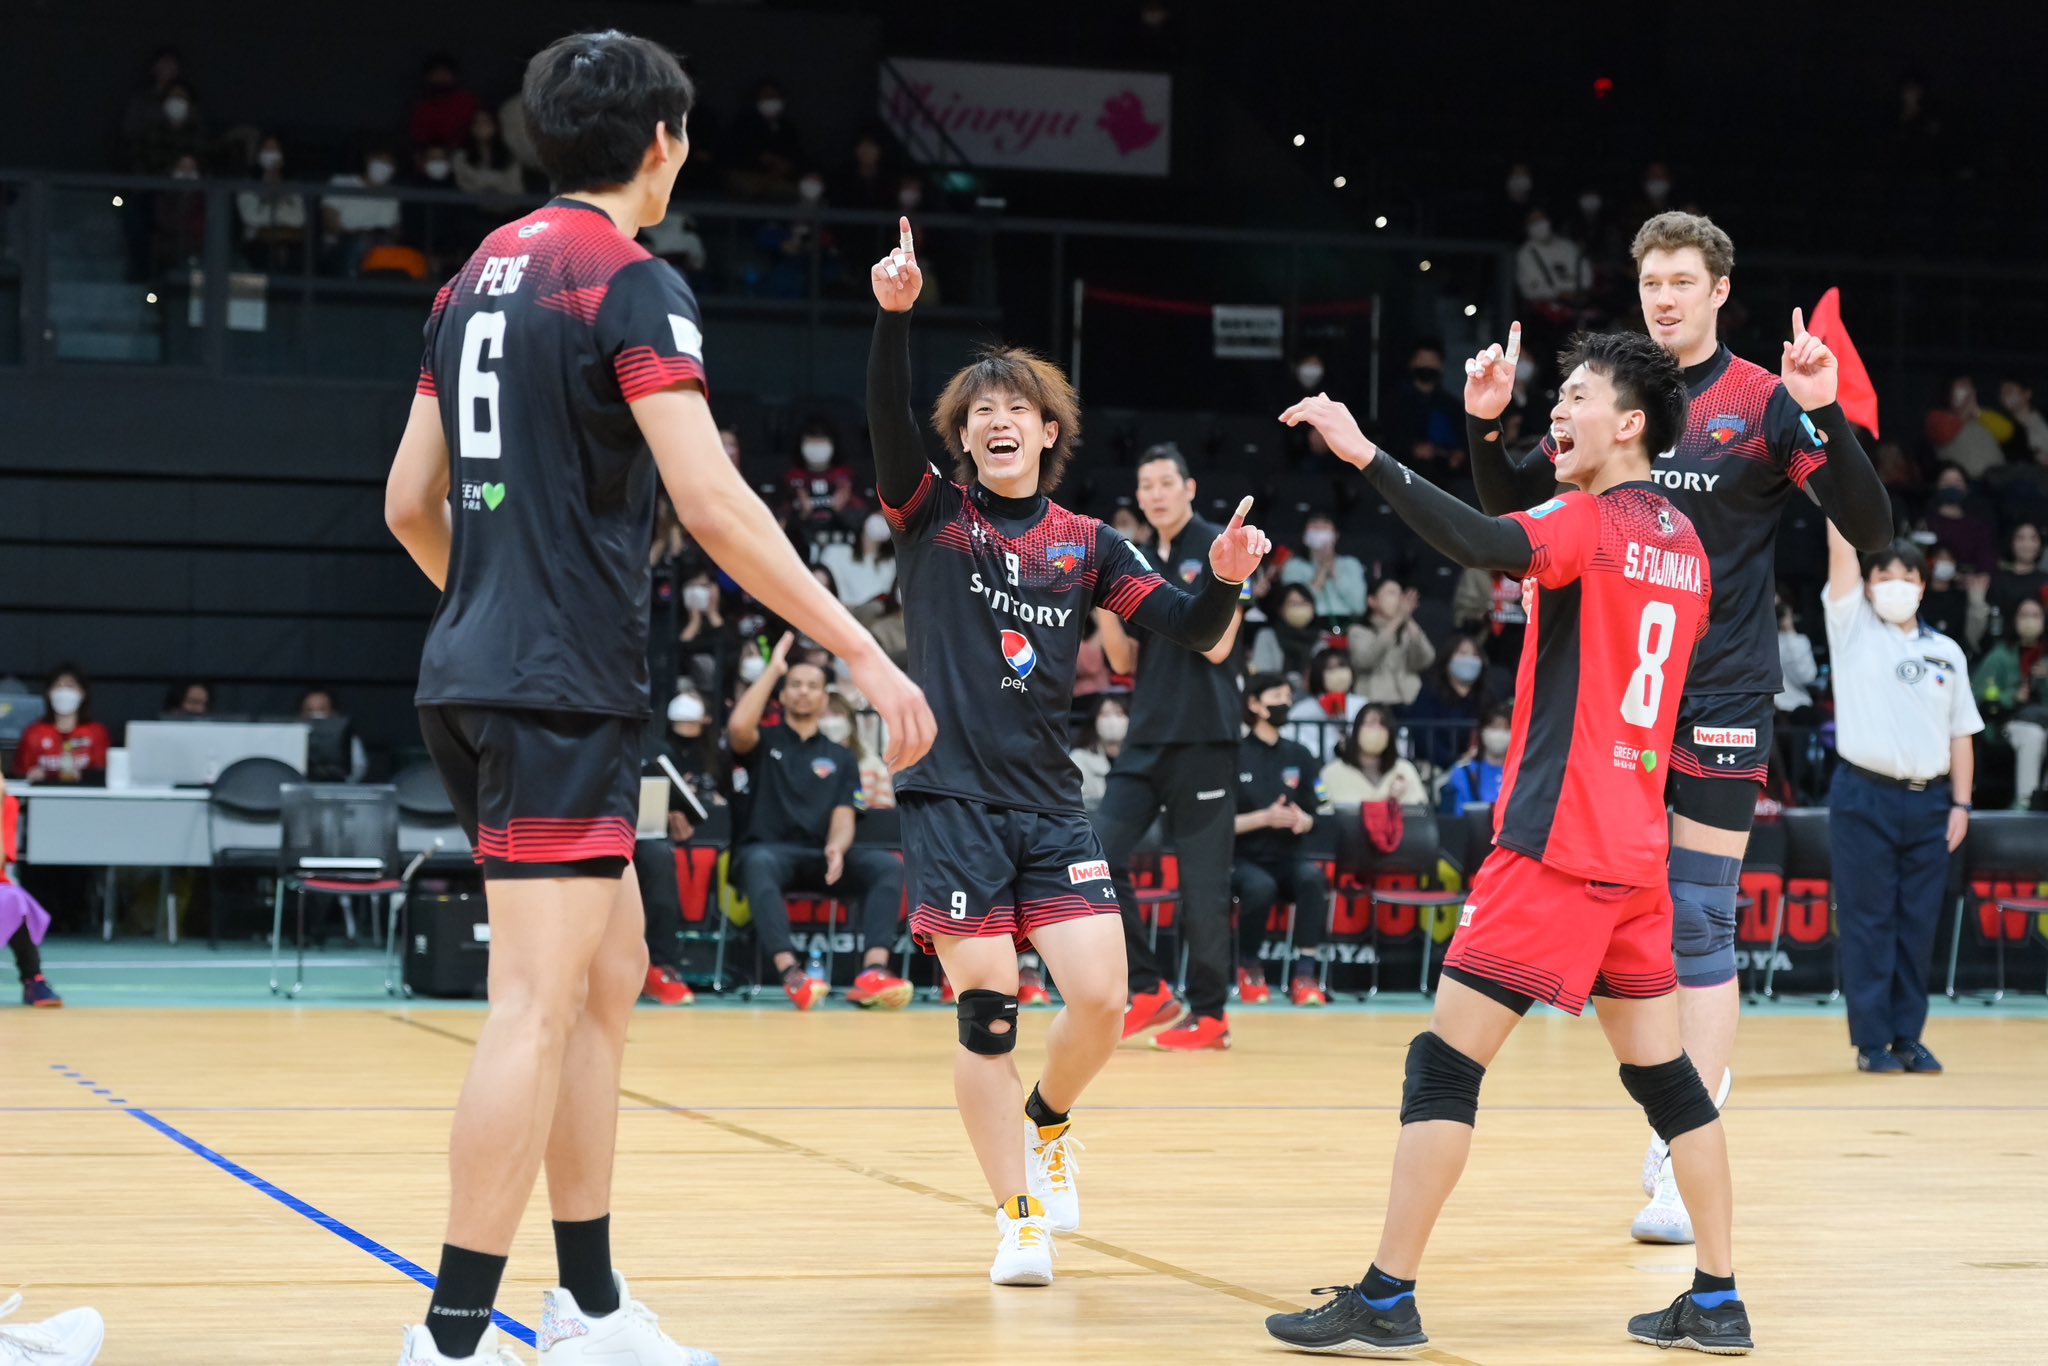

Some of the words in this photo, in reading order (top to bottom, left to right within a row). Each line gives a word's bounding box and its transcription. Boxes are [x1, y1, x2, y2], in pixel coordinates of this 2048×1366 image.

[474, 254, 530, 296] PENG
[458, 311, 507, 459] 6
[1005, 551, 1020, 587] 9
[1623, 541, 1703, 594] S.FUJINAKA
[970, 573, 1073, 627] SNTORY
[1619, 600, 1677, 729] 8
[1613, 745, 1640, 761] GREEN
[1696, 729, 1754, 745] Iwatani
[950, 891, 967, 920] 9
